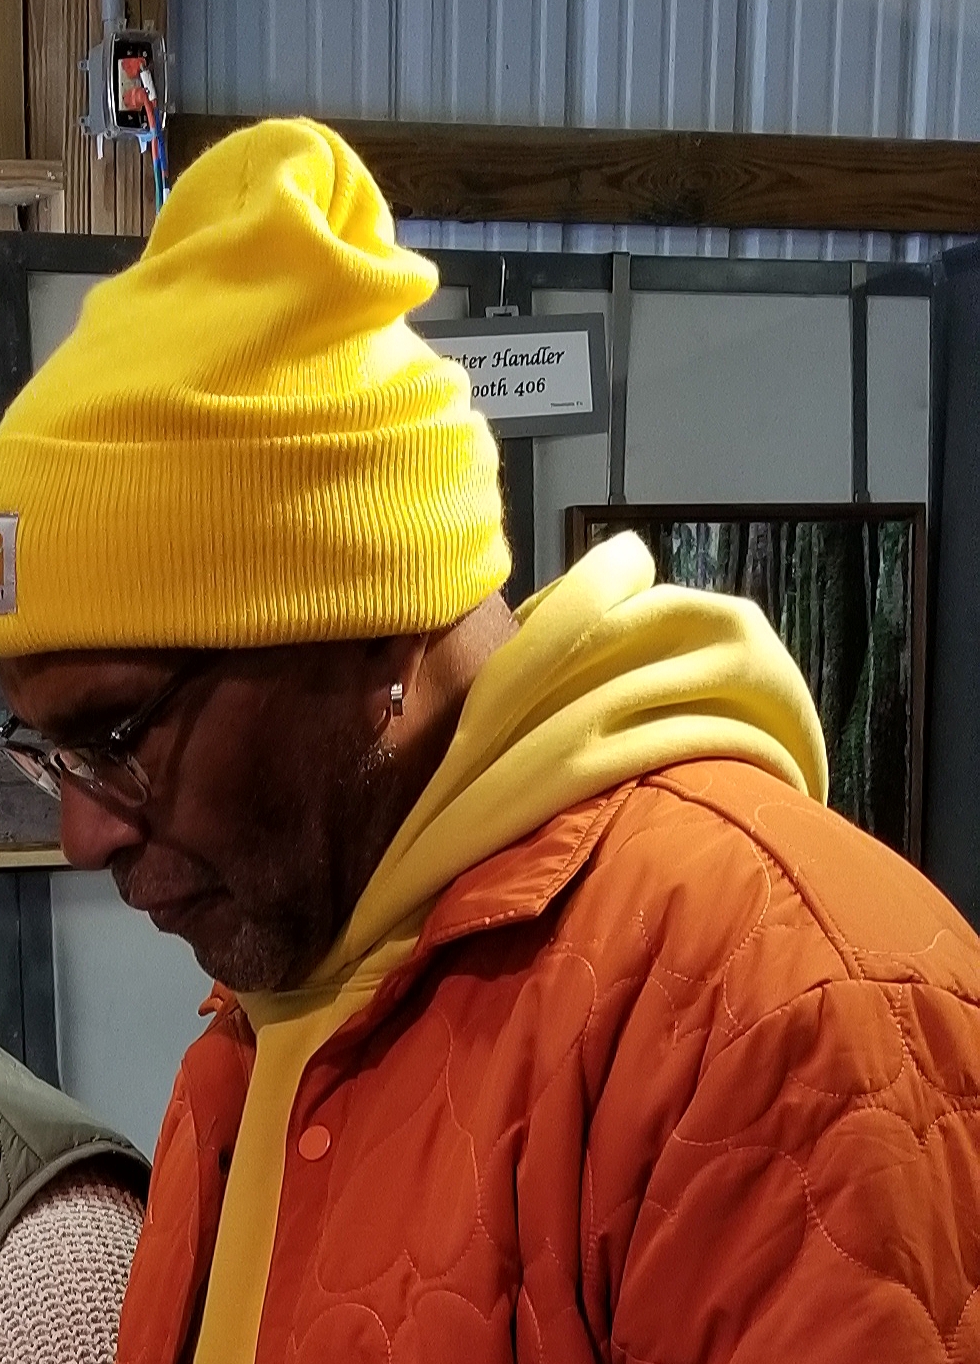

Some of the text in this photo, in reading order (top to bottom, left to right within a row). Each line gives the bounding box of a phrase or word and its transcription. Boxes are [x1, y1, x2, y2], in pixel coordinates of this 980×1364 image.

[441, 346, 565, 369] ter Handler
[471, 377, 546, 398] ooth 406
